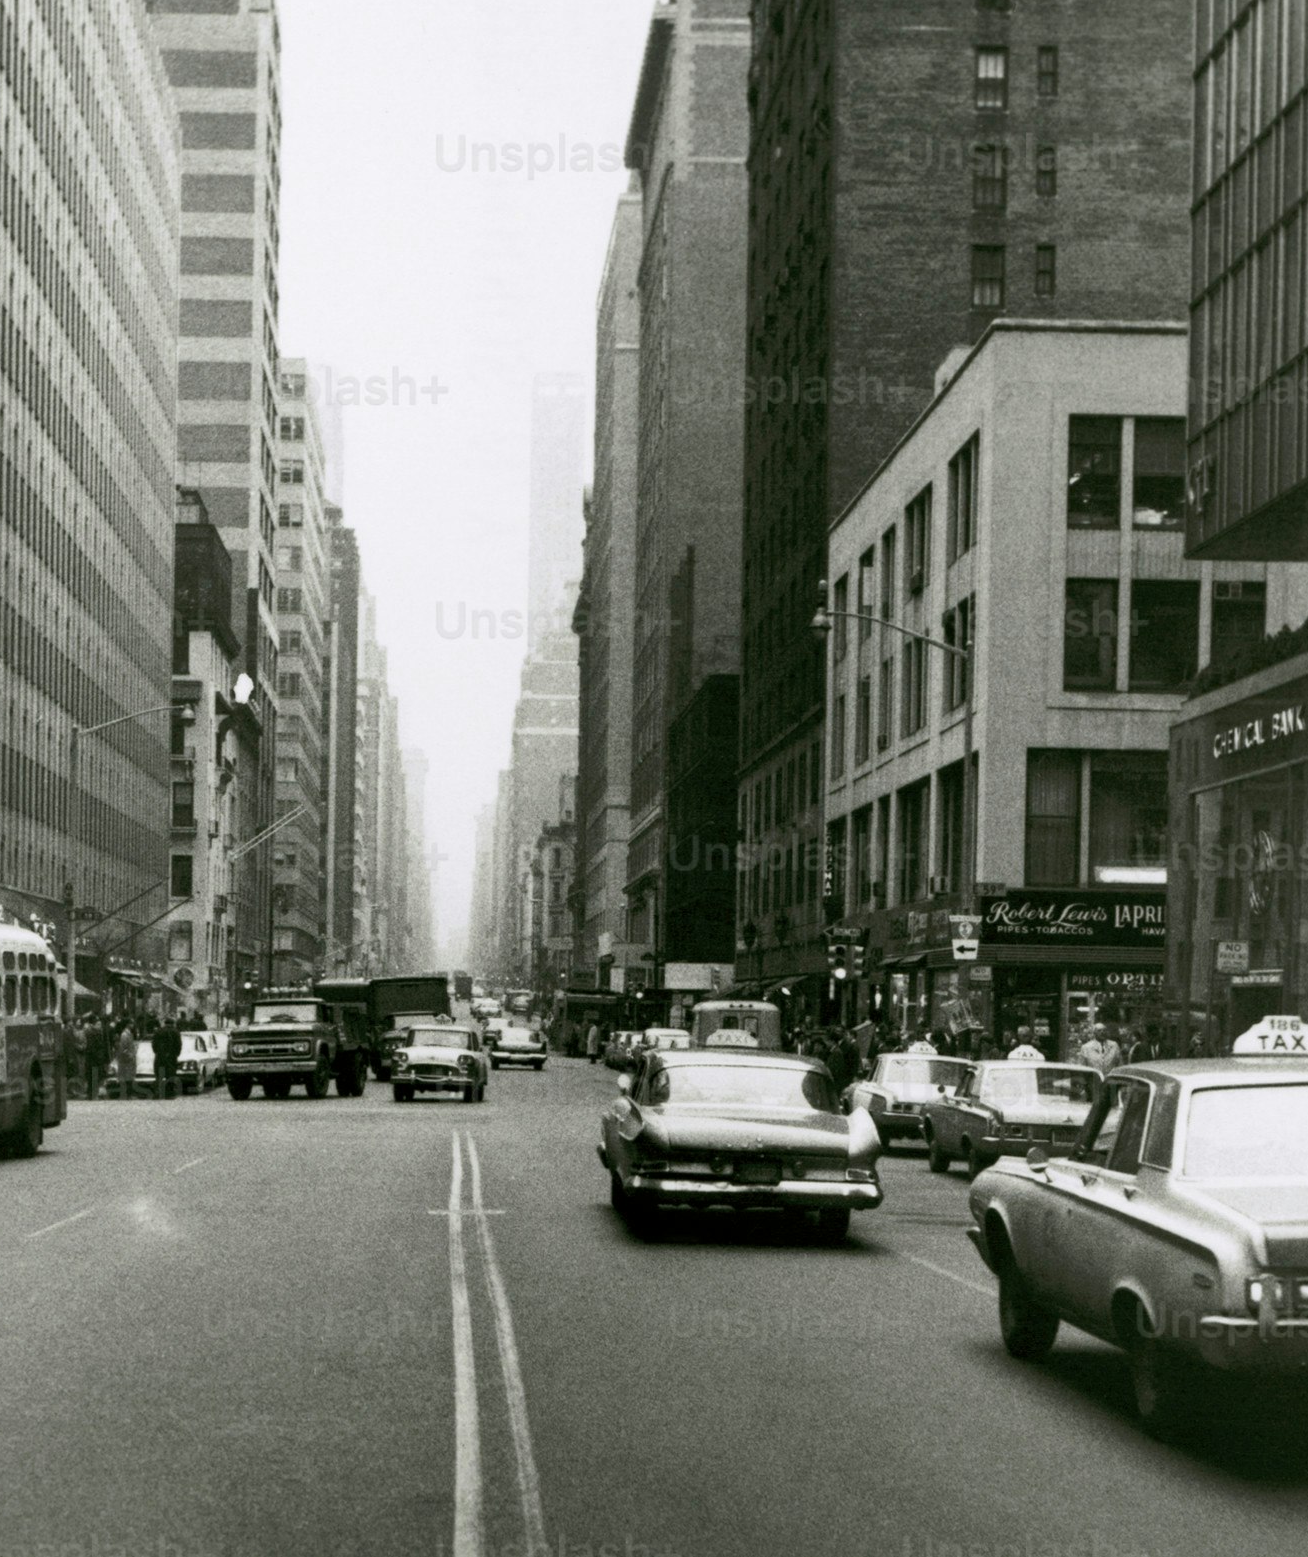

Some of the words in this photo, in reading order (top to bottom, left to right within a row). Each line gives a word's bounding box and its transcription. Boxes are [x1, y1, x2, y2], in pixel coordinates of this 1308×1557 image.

[1213, 719, 1265, 758] CHEMICAL
[1271, 705, 1305, 740] BANK
[986, 901, 1057, 925] Robert
[1049, 903, 1108, 928] Lewis
[997, 925, 1030, 934] PIPES
[1035, 925, 1094, 936] TOBACCOS
[1225, 943, 1241, 952] NO
[1072, 975, 1100, 985] PIPES
[1269, 1018, 1301, 1031] 186
